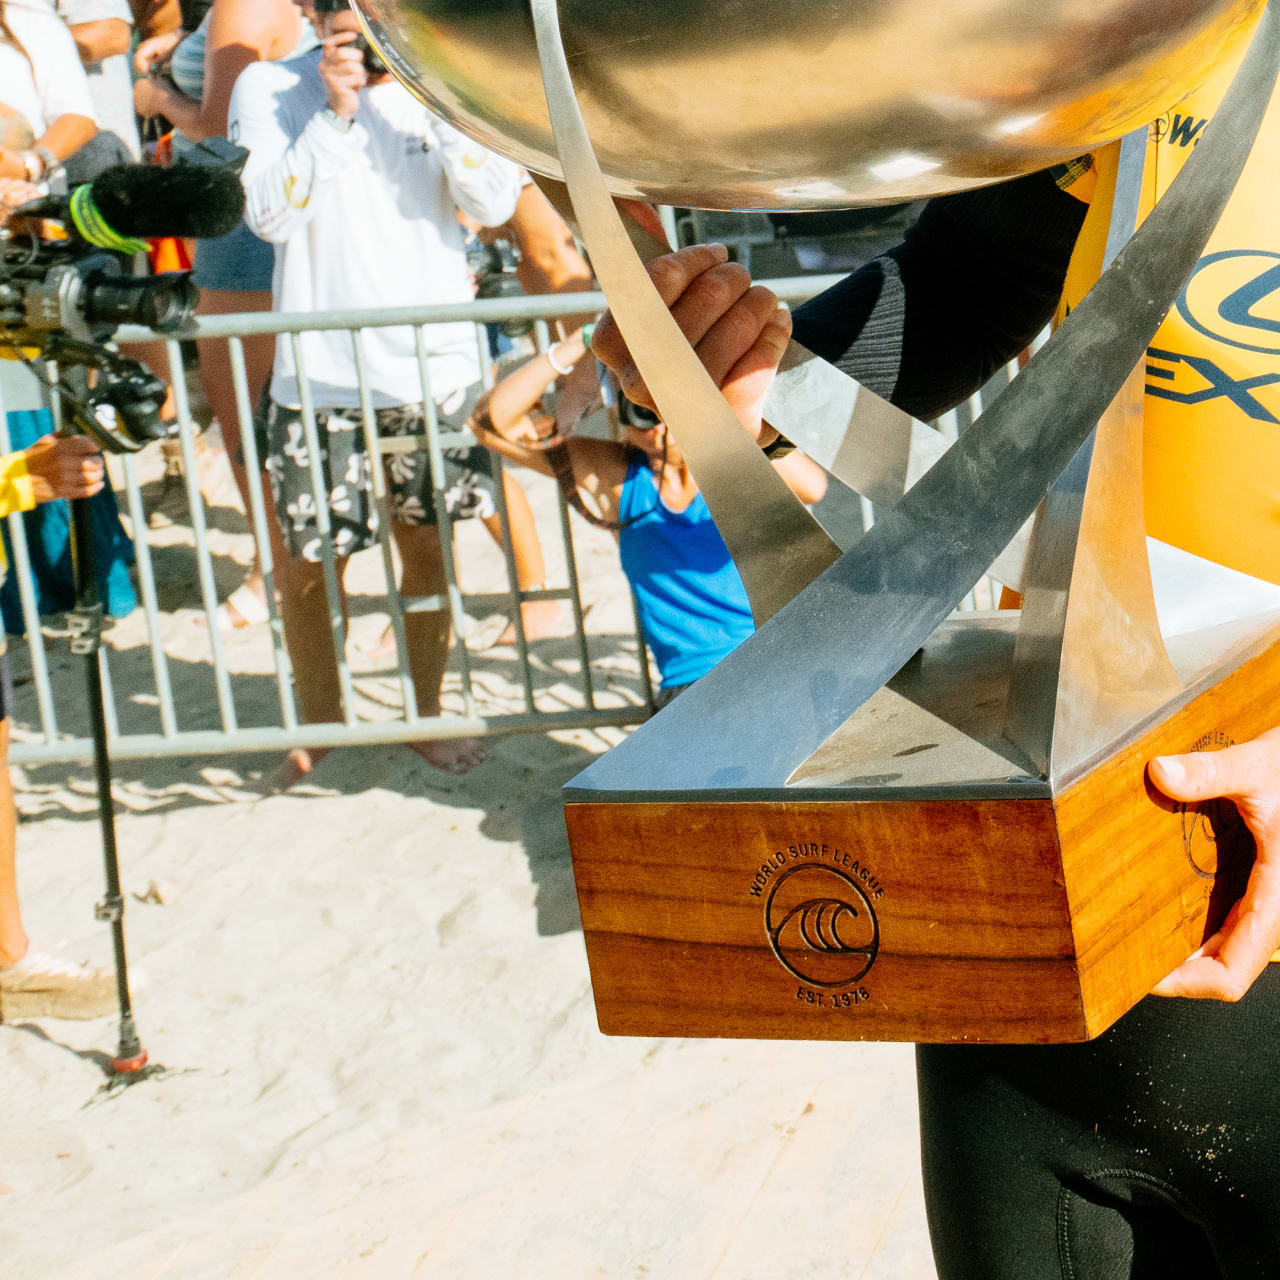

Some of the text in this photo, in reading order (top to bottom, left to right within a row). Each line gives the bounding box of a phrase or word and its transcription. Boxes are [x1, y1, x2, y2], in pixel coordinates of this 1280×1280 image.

[750, 843, 887, 900] WORLD SURF LEAGUE
[796, 985, 870, 1008] EST. 1976
